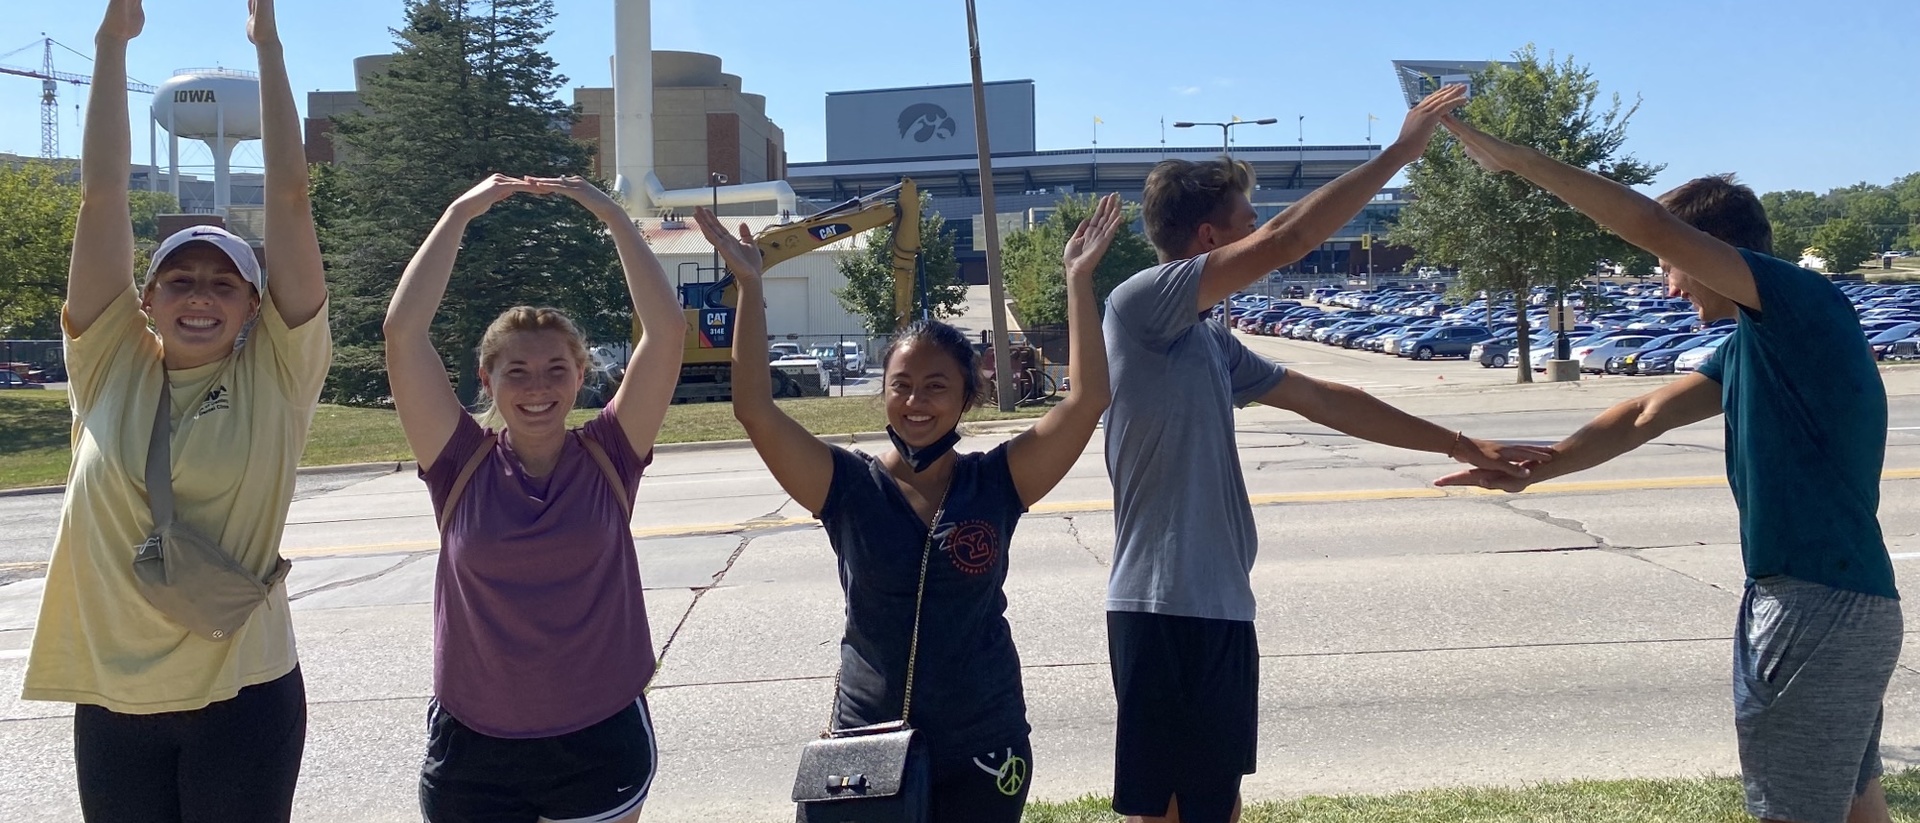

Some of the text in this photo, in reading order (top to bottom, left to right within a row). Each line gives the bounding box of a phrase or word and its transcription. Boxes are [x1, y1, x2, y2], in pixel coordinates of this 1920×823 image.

[174, 90, 216, 103] IOWA
[819, 224, 837, 240] CAT
[707, 312, 727, 326] CAT
